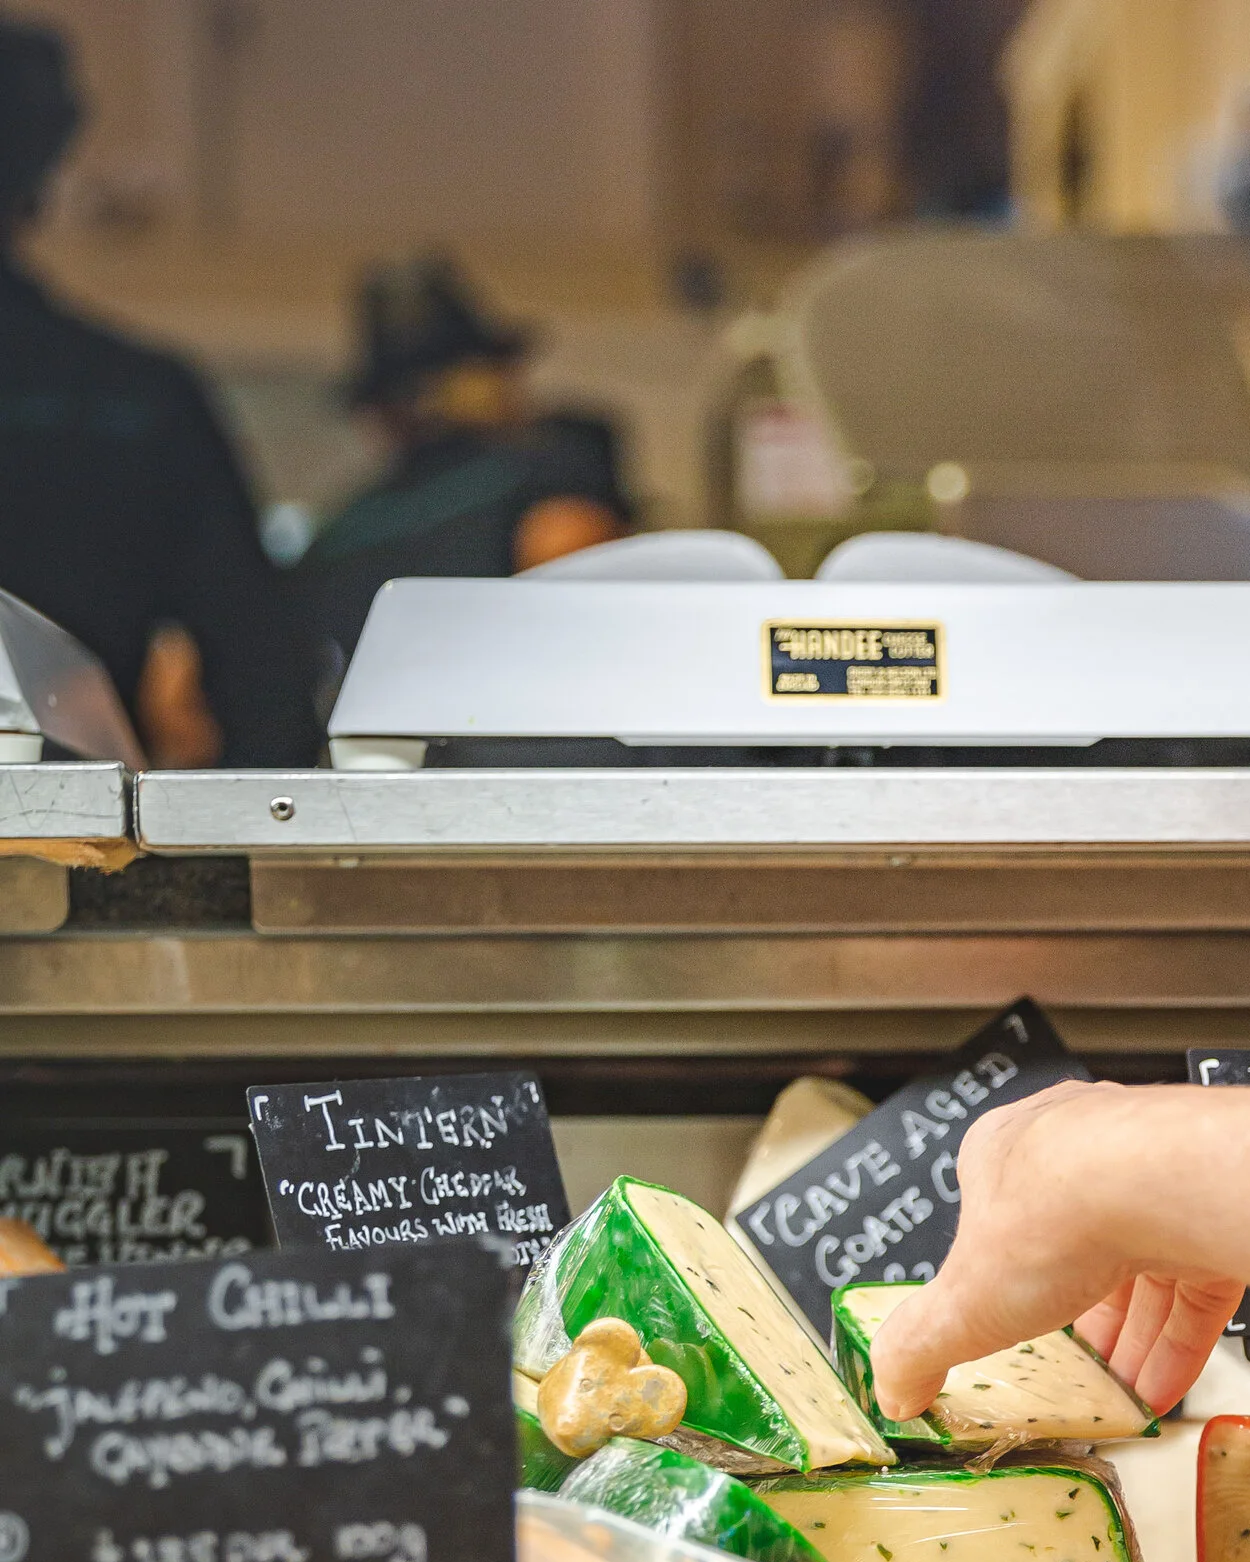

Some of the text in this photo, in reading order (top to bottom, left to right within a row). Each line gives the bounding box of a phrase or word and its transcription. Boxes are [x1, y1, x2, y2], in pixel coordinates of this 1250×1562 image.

[304, 1090, 507, 1150] TINTERN
[775, 1139, 900, 1247] CAVE
[900, 1052, 1018, 1160] AGED
[324, 1218, 428, 1251] FLAVOURS
[496, 1200, 553, 1233] FRESH
[815, 1186, 934, 1287] GOATS
